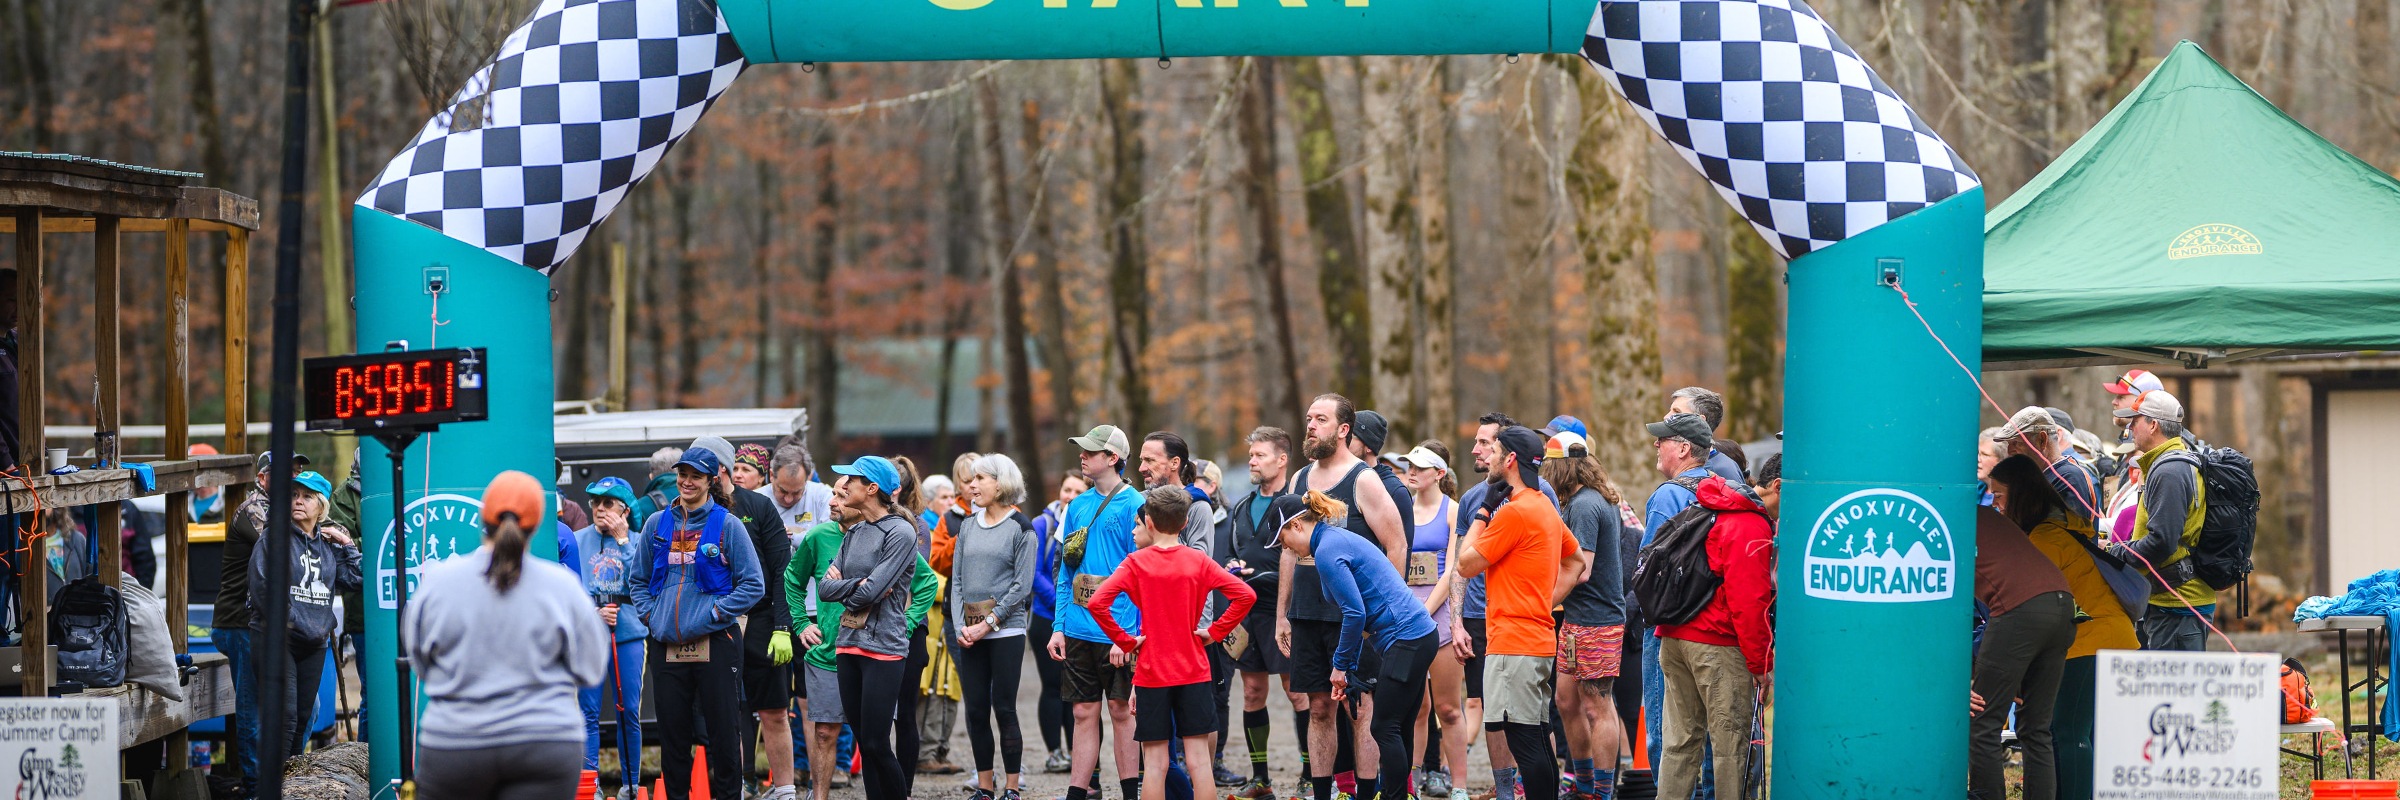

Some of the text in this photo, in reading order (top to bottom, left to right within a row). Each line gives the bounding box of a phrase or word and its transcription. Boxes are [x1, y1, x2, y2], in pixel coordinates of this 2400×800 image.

[2180, 226, 2249, 243] KNOXVILLE
[2173, 244, 2257, 256] ENDURANCE
[1824, 500, 1941, 543] KNOXVILLE
[1410, 566, 1425, 576] 719
[1811, 564, 1946, 594] ENDURANCE
[2111, 656, 2267, 678] Register now for
[2116, 677, 2264, 702] Summer Camp!
[51, 706, 80, 720] now
[86, 702, 106, 720] for
[2150, 703, 2194, 736] Camp
[59, 723, 106, 745] Camp!
[19, 747, 53, 781] Camp
[2112, 765, 2262, 788] 865-448-2246
